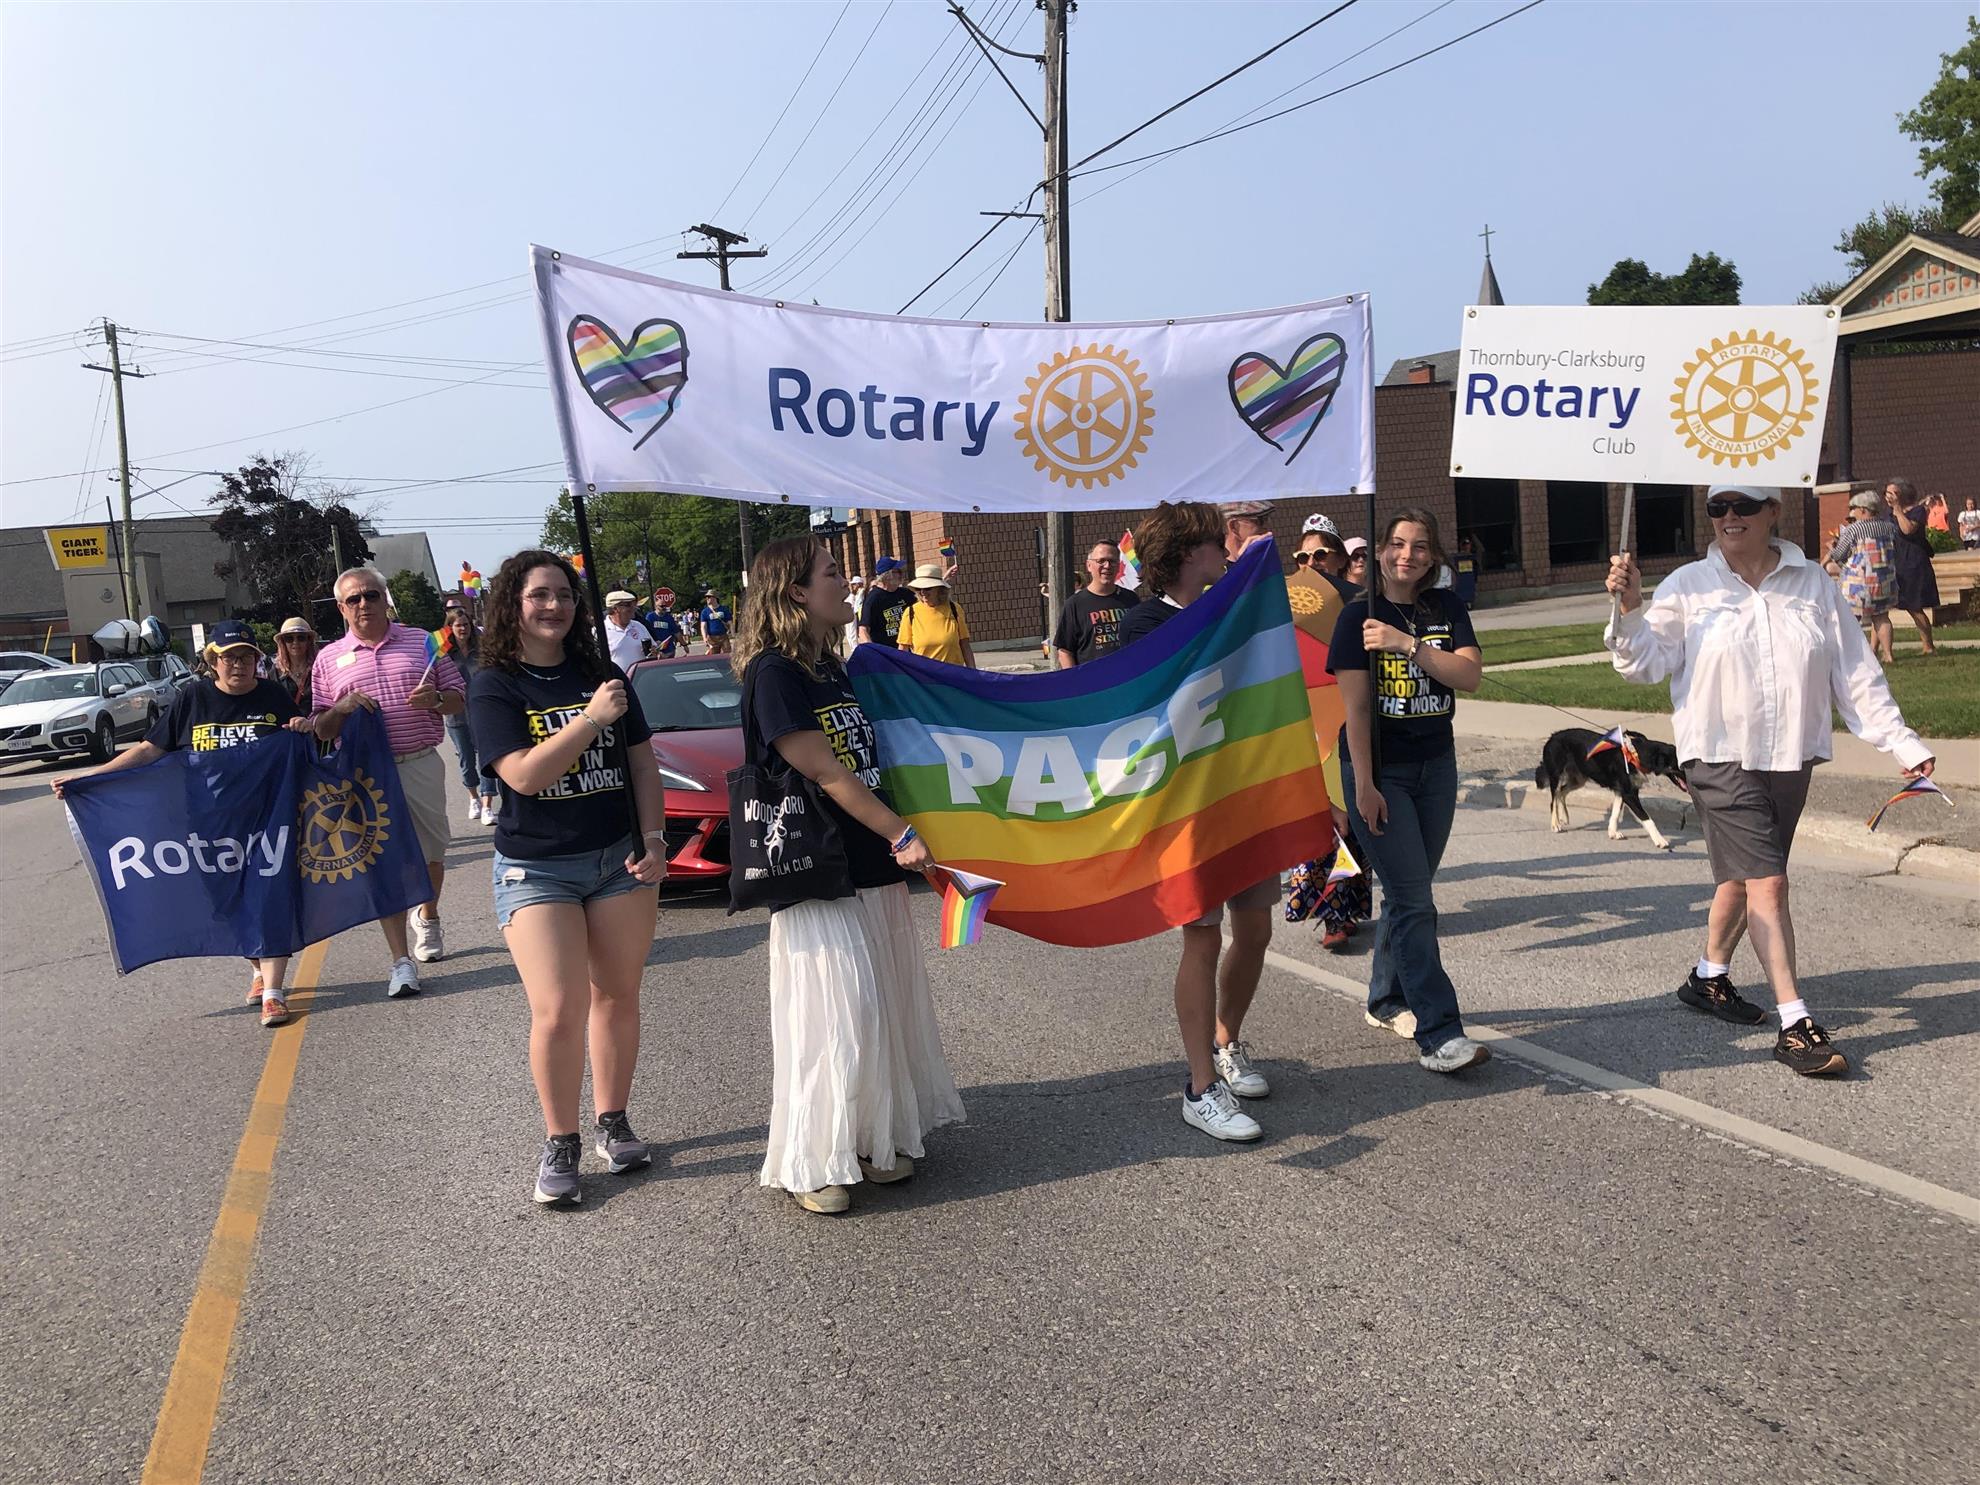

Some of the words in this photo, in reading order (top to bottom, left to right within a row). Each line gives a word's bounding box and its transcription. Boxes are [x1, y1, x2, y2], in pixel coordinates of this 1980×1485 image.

[1470, 349, 1645, 372] Thornbury-Clarksburg
[1719, 345, 1780, 360] ROTARY
[768, 366, 999, 457] Rotary
[1465, 373, 1641, 429] Rotary
[1592, 437, 1636, 454] Club
[1691, 420, 1793, 453] INTERNATIONAL
[61, 538, 98, 548] GIANT
[63, 547, 99, 557] TIGER
[655, 593, 674, 602] STOP
[1089, 608, 1129, 625] PRID
[1410, 694, 1451, 714] WORLD
[817, 707, 868, 735] ELIEVE
[192, 726, 255, 742] BELIEVE
[828, 728, 863, 754] HERE
[583, 749, 603, 770] IN
[578, 767, 624, 792] WORL
[108, 825, 290, 891] Rotary
[744, 866, 769, 880] HORROR
[771, 861, 791, 877] FILM
[792, 855, 814, 872] CLUB
